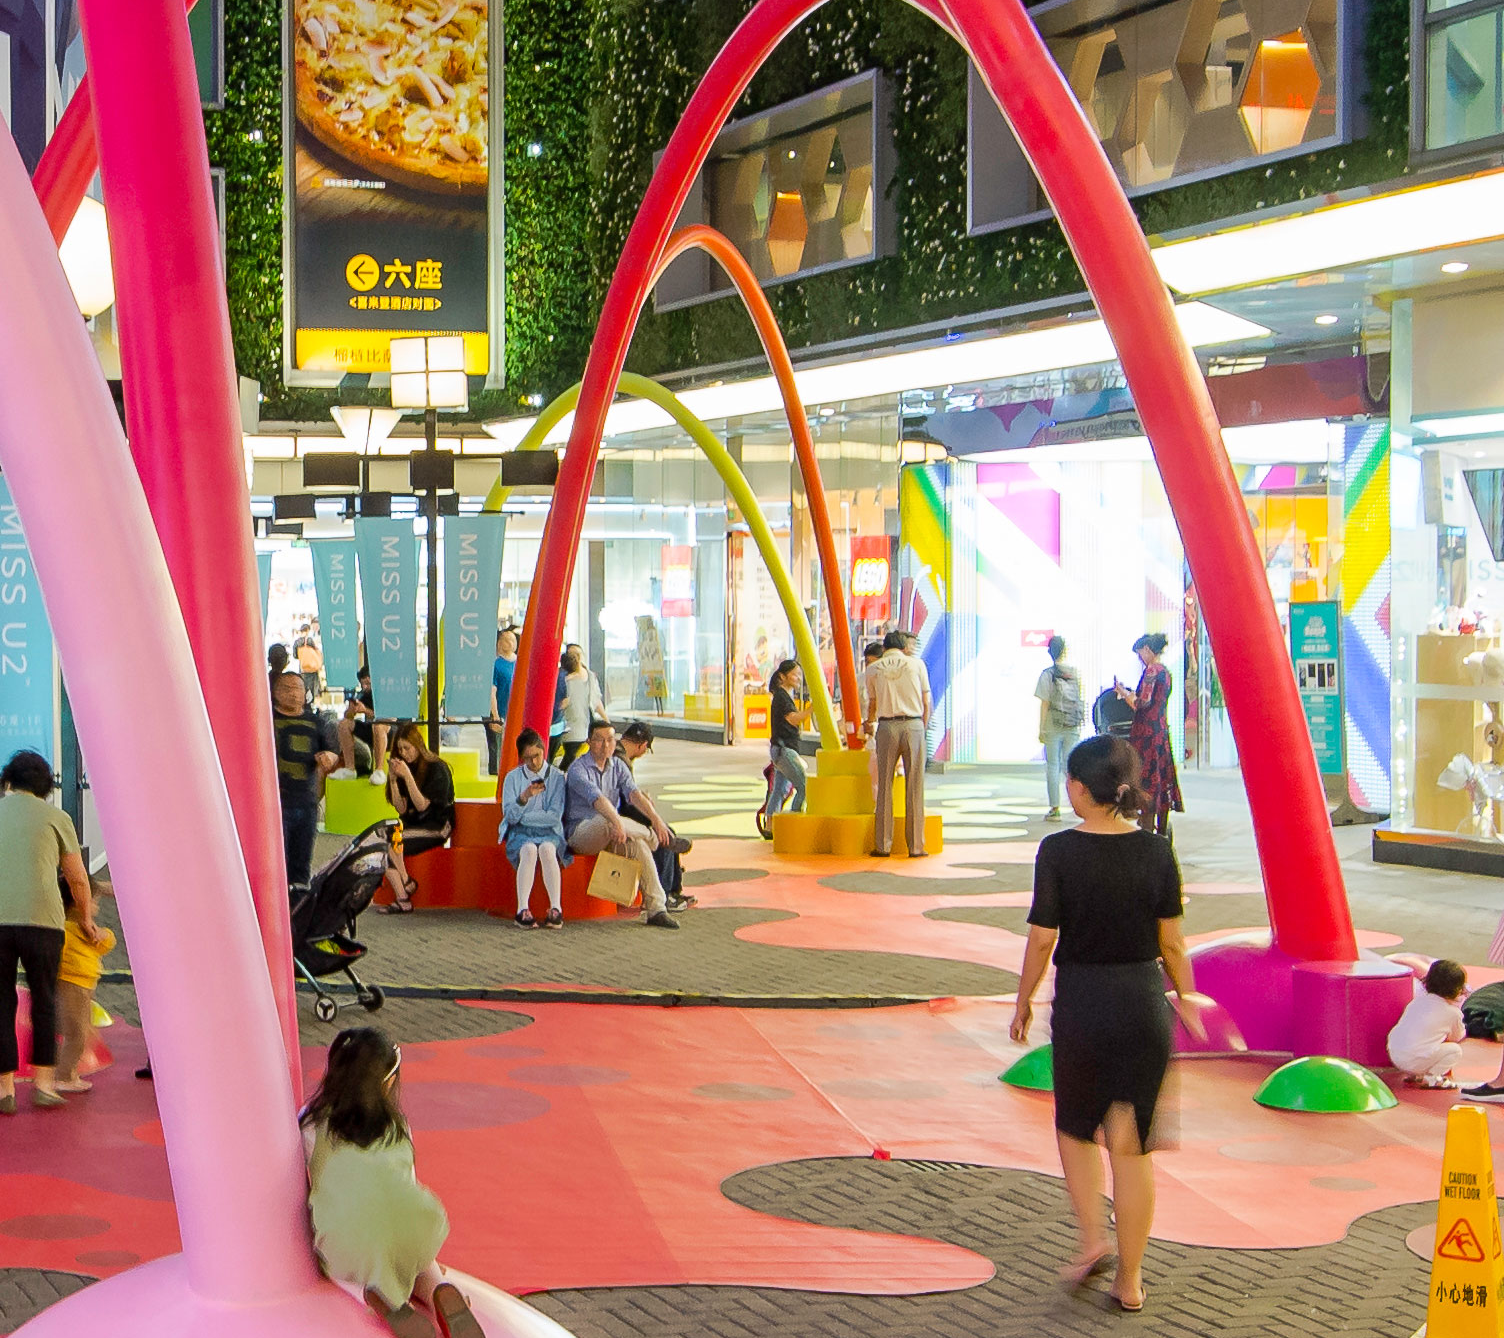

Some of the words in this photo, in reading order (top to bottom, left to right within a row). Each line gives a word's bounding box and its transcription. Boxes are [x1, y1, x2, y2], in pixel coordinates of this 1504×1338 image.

[383, 258, 444, 290] 六座
[0, 503, 28, 605] MISS
[380, 535, 401, 605] MISS
[458, 533, 479, 603] MISS
[330, 553, 345, 605] MISS
[852, 557, 889, 597] LEGO
[331, 613, 345, 641] U2
[381, 614, 401, 653] U2
[459, 612, 480, 650] U2
[1, 622, 28, 676] U2
[747, 712, 767, 725] LEGO
[1444, 1185, 1458, 1199] WET
[1459, 1187, 1481, 1201] FLOOR
[1448, 1171, 1478, 1185] CAUTION
[1435, 1280, 1488, 1309] 小心地滑
